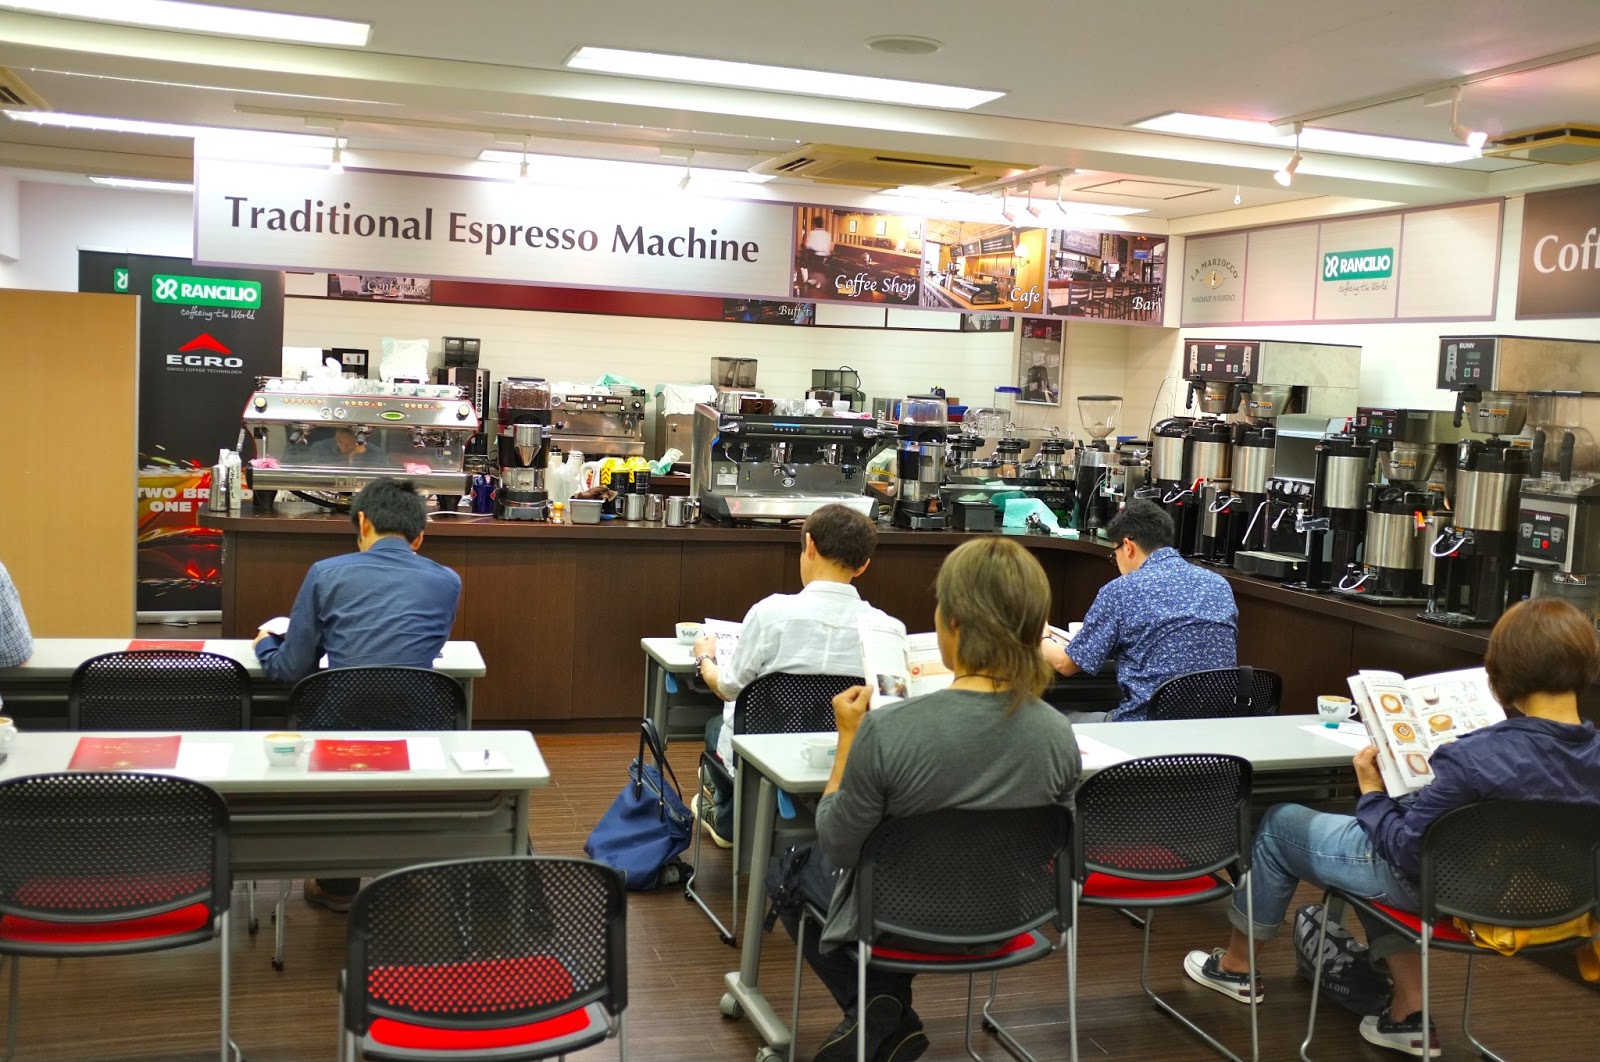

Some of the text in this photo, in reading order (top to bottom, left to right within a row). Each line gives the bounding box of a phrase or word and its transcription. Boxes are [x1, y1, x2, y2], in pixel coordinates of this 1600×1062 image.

[224, 196, 759, 262] Traditional Espresso Machine
[1191, 258, 1239, 281] LA MARZOCCO
[1340, 255, 1391, 273] RANCILIO
[181, 283, 257, 302] RANCILIO
[367, 279, 428, 294] Conference
[834, 274, 917, 301] Coffee Shop
[1010, 286, 1040, 309] Cafe
[1132, 296, 1158, 311] Bar
[213, 309, 229, 319] the
[230, 310, 255, 320] World
[779, 301, 810, 320] Buffet
[166, 354, 243, 368] EGRO
[138, 487, 254, 500] TWO BRD
[149, 501, 192, 513] ONE
